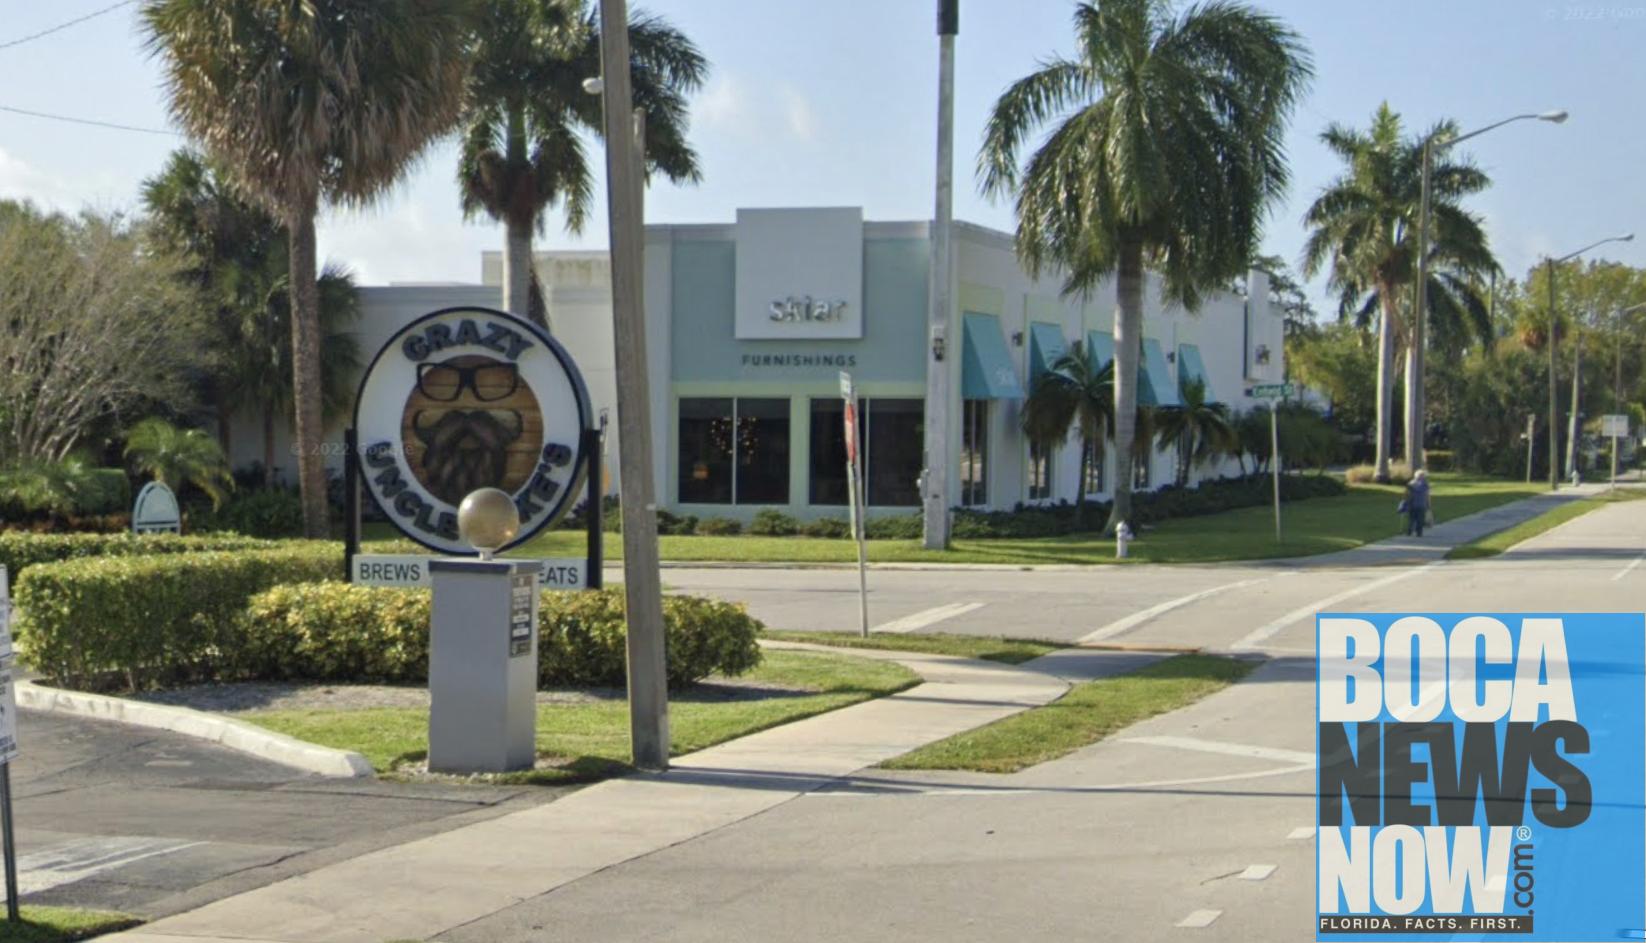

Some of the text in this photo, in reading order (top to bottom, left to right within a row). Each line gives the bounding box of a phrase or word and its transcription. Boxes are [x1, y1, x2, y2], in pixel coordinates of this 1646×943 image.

[741, 355, 857, 367] FURNISHINGS
[366, 441, 572, 541] UNCLE KE'S
[359, 562, 421, 581] BREWS
